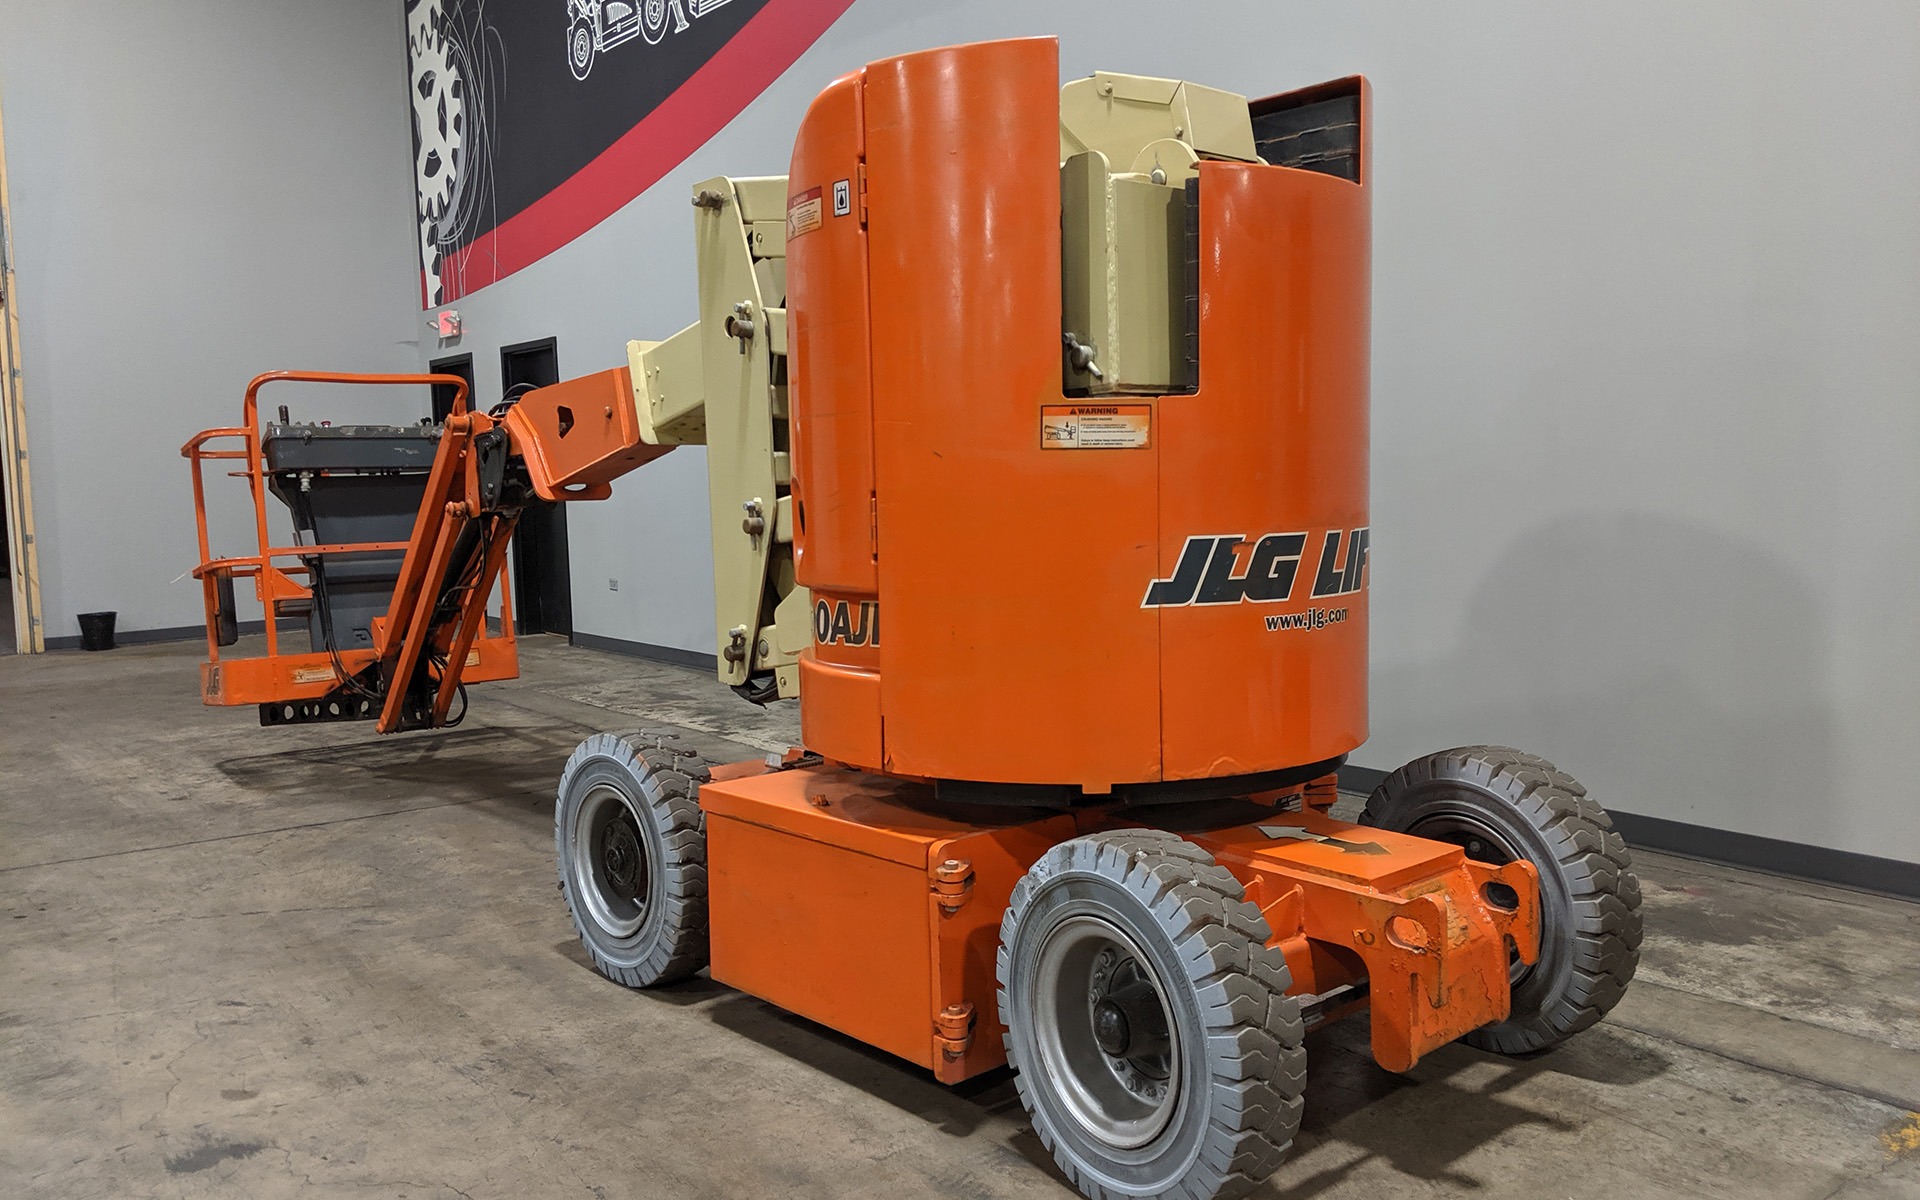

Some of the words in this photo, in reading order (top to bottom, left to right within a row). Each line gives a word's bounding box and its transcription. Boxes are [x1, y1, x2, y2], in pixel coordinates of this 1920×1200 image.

[1078, 407, 1118, 415] WARNING
[1140, 531, 1309, 608] JLG
[1309, 526, 1369, 599] LIF
